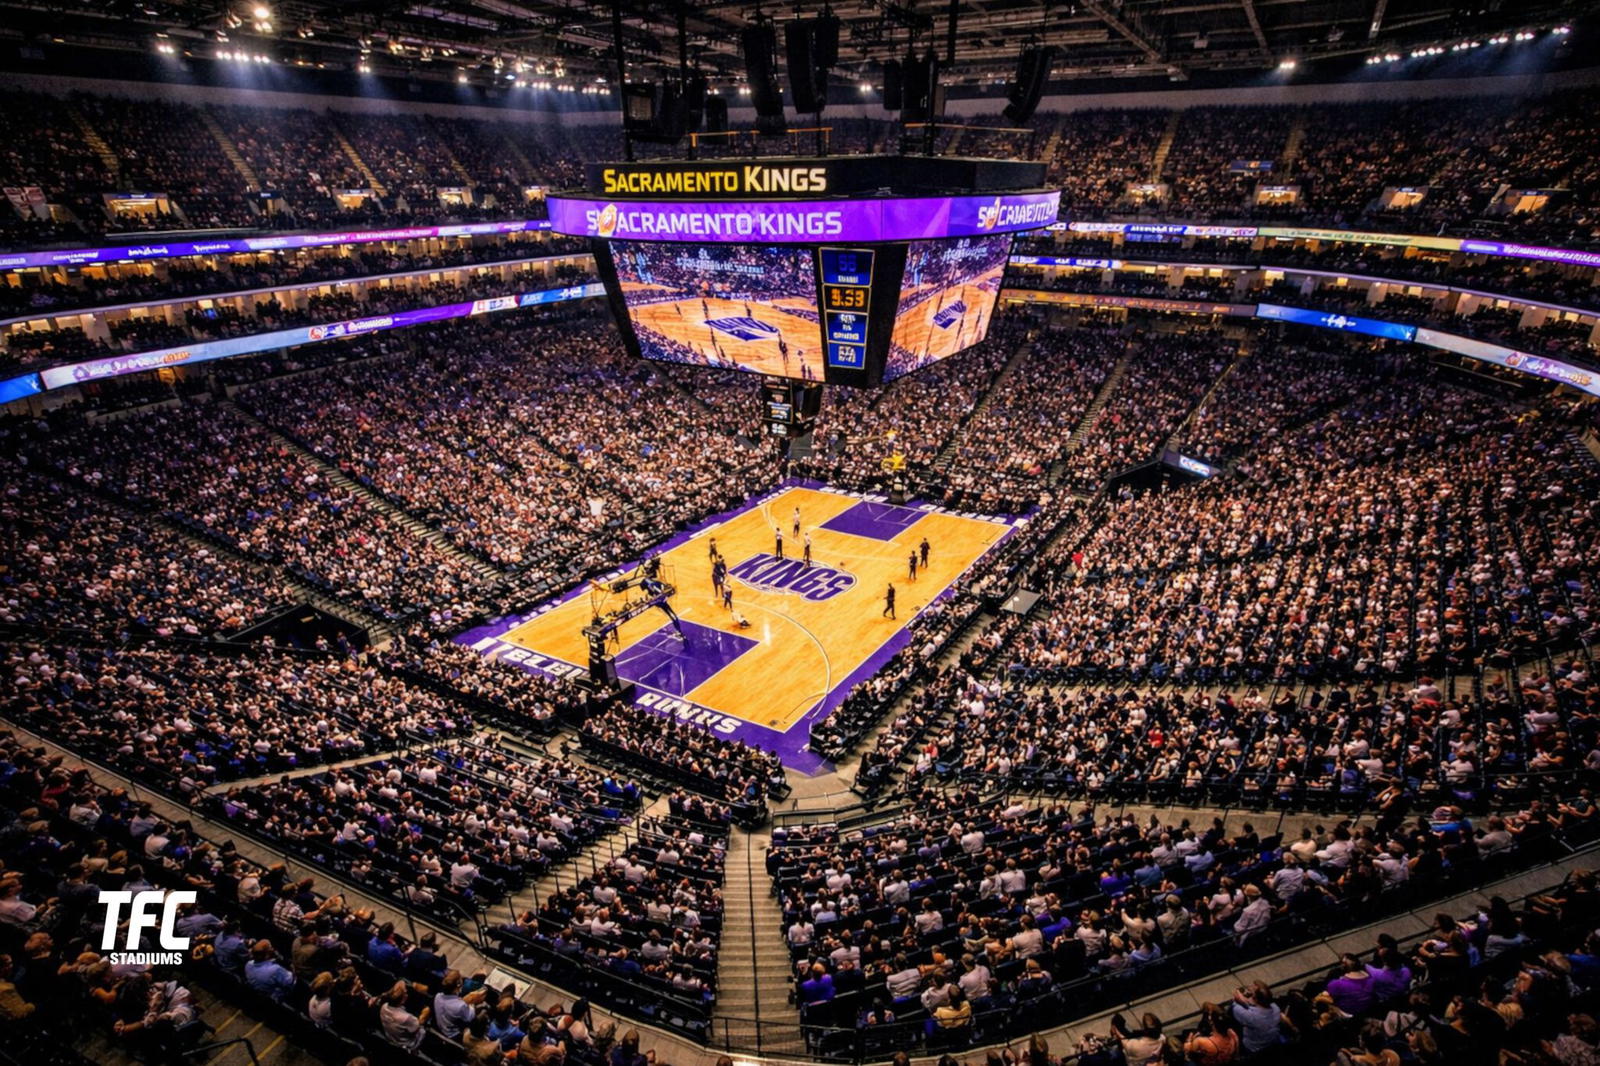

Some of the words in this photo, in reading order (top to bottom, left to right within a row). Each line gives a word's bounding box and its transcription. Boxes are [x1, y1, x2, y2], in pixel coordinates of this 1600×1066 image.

[603, 168, 738, 193] SACRAMENTO
[744, 165, 827, 192] KINGS
[760, 211, 843, 235] KINGS
[727, 553, 855, 601] KINGS
